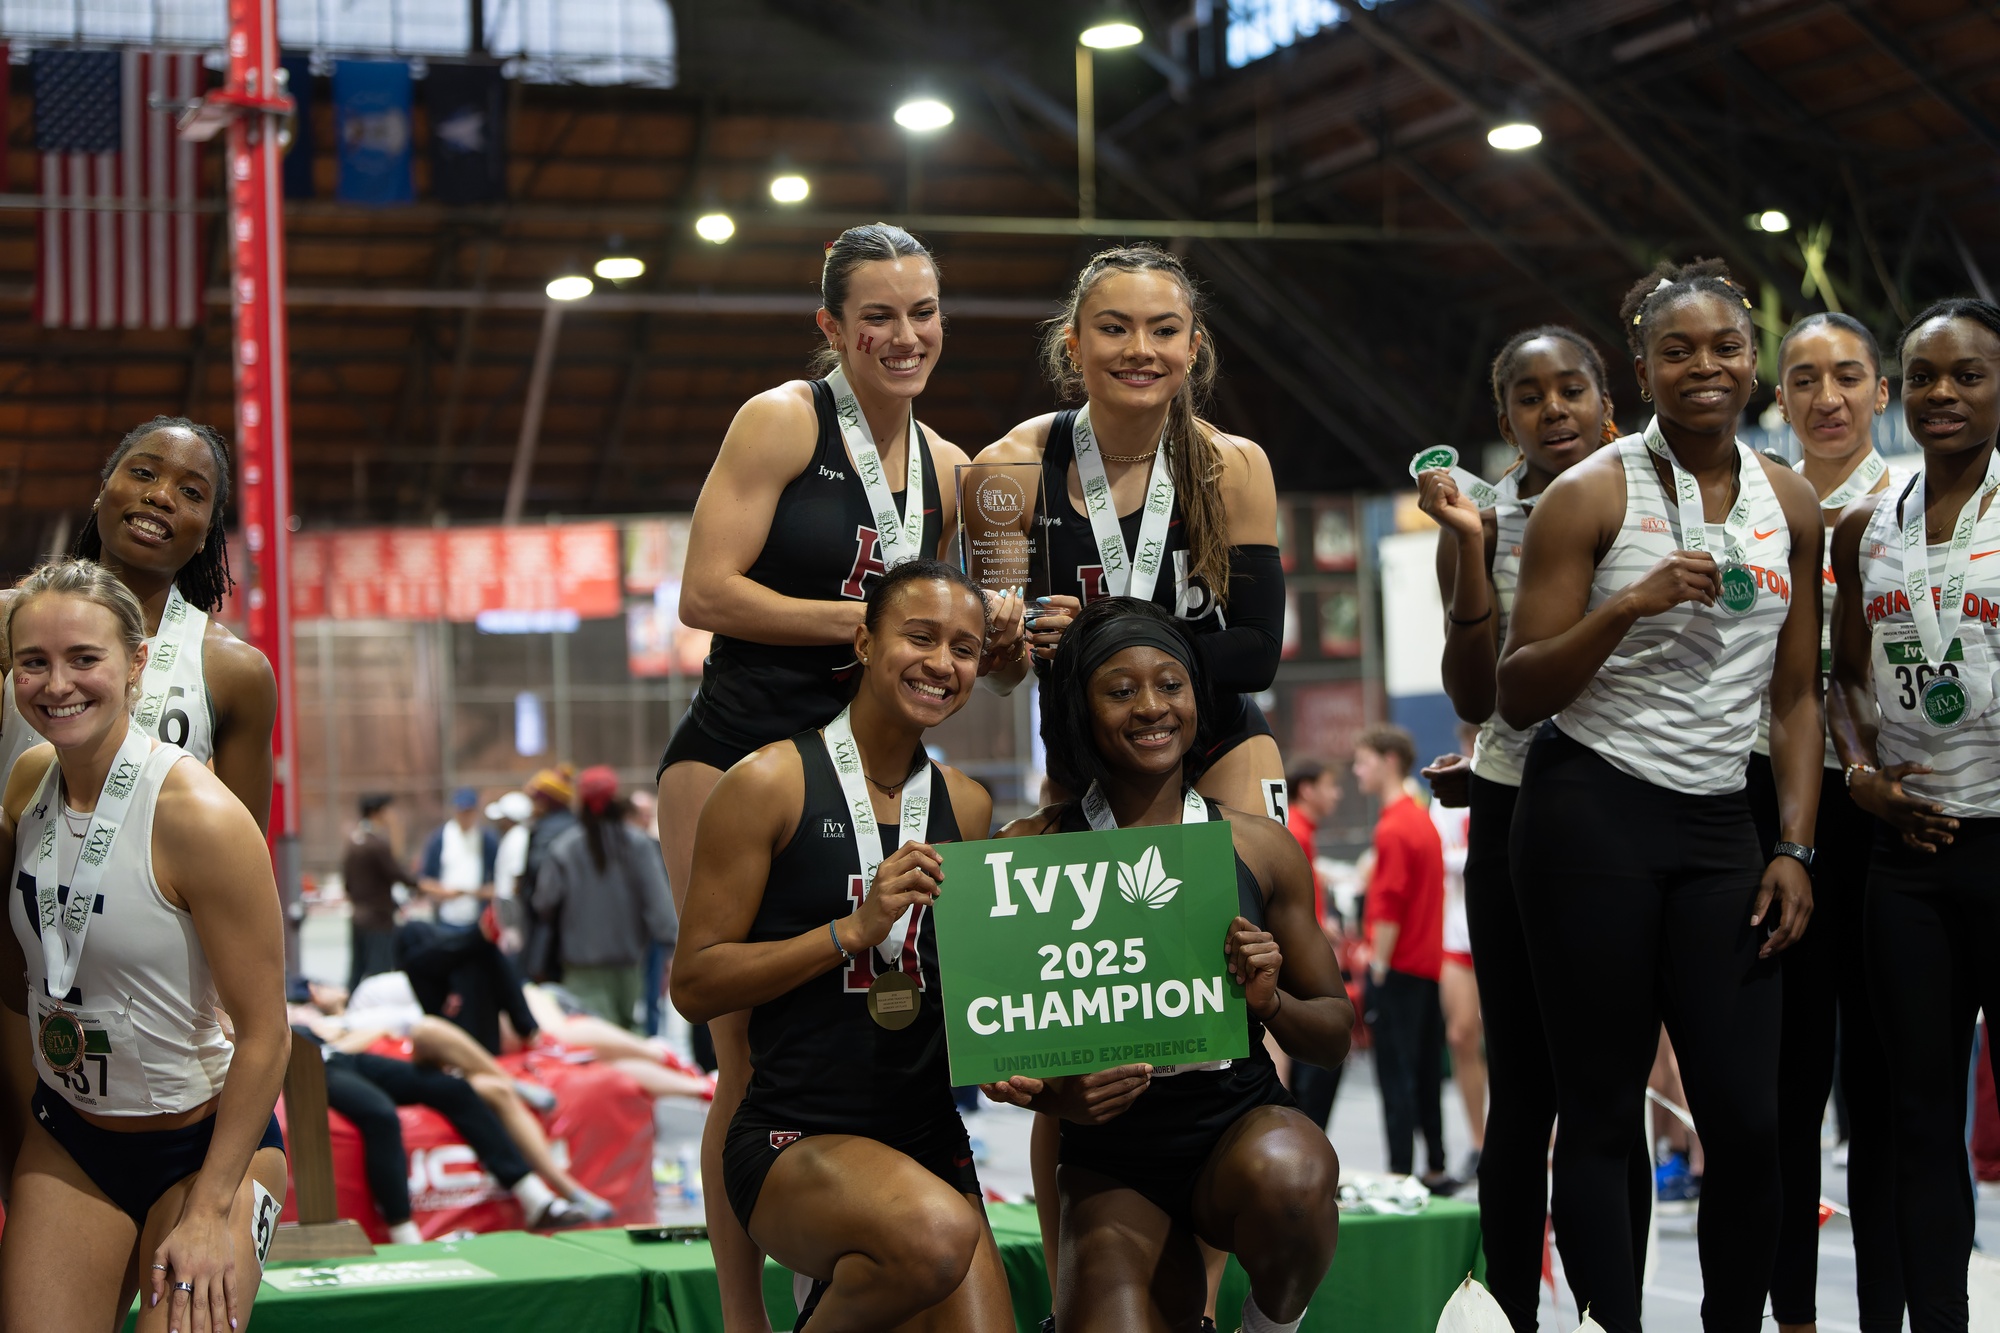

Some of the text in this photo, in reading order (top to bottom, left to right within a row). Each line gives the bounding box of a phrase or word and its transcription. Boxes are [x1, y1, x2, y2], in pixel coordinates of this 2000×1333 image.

[857, 333, 874, 354] H
[842, 404, 860, 428] IVY
[1079, 428, 1092, 453] IVY
[818, 465, 836, 480] Ivy
[864, 461, 880, 486] IVY
[993, 493, 1018, 506] IVY
[1092, 486, 1107, 511] IVY
[1154, 479, 1167, 506] IVY
[1683, 478, 1696, 502] IVY
[883, 520, 899, 546] IVY
[1648, 520, 1667, 529] IVY
[1910, 524, 1919, 547] IVY
[1958, 517, 1970, 540] IVY
[1001, 538, 1036, 547] Heptagonal
[1142, 537, 1157, 565] IVY
[1691, 537, 1702, 551] IV
[982, 556, 1029, 564] Championships
[1107, 545, 1123, 571] IVY
[1728, 581, 1750, 597] IVY
[1913, 577, 1926, 602] IVY
[1946, 574, 1959, 600] IVY
[171, 595, 182, 617] IVY
[1866, 587, 1999, 630] PRINEON
[157, 640, 174, 664] IVY
[142, 692, 158, 718] IVY
[1936, 692, 1960, 711] IVY
[158, 686, 190, 749] 6
[834, 741, 852, 765] IVY
[113, 757, 135, 790] IVY
[853, 798, 870, 825] IVY
[1269, 784, 1285, 827] 5
[823, 822, 846, 833] IVY
[909, 805, 922, 832] IVY
[44, 831, 52, 858] IVY
[89, 823, 109, 854] IVY
[983, 850, 1109, 931] Ivy
[44, 899, 57, 928] IVY
[69, 890, 86, 923] IVY
[1037, 937, 1147, 981] 2025
[966, 976, 1224, 1036] CHAMPION
[53, 1034, 75, 1048] IVY
[993, 1037, 1208, 1073] UNRIVALED EXPERIENCE
